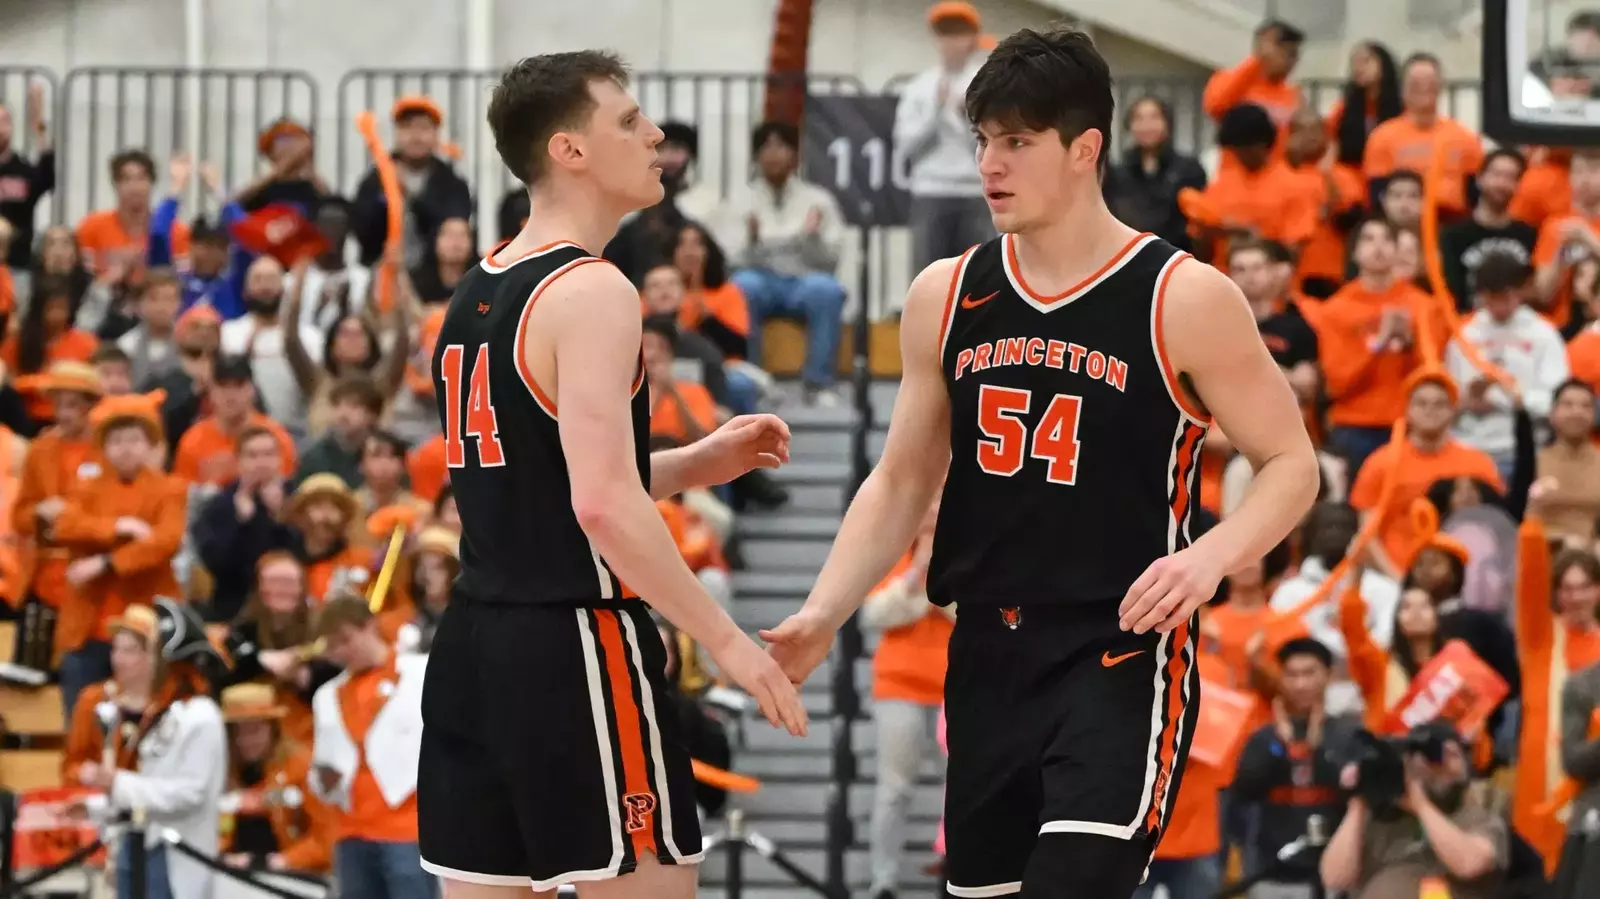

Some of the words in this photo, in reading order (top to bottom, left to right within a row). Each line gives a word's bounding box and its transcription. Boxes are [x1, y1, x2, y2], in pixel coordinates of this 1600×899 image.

[955, 337, 1128, 393] PRINCETON
[441, 342, 506, 468] 14
[976, 384, 1083, 486] 54
[622, 791, 656, 833] P
